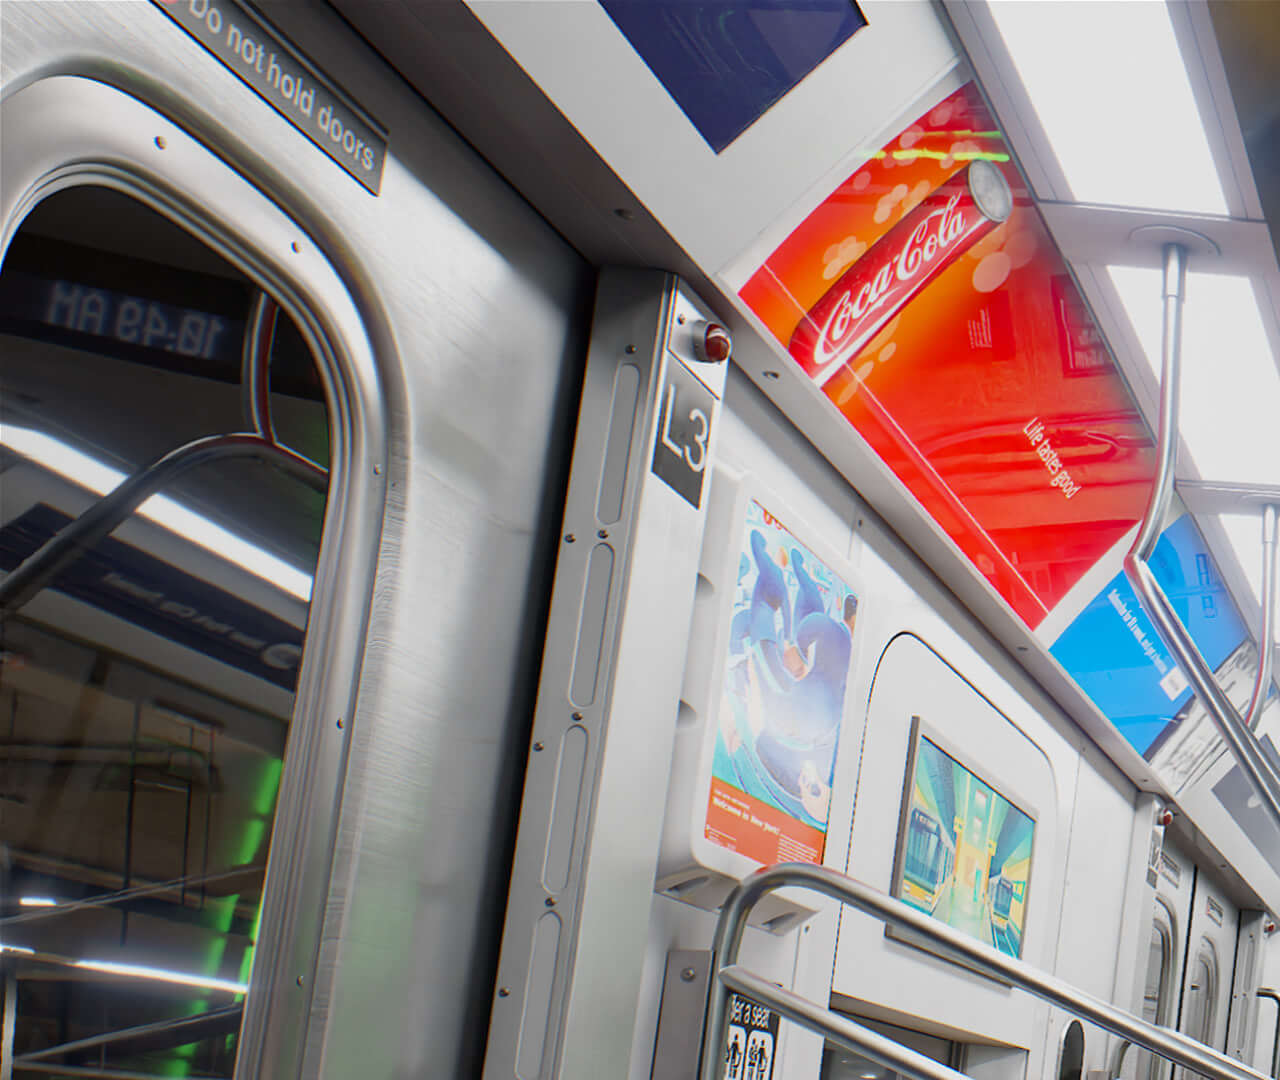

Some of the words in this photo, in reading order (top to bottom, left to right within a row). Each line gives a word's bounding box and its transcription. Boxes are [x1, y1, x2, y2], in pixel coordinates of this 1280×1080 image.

[226, 23, 264, 74] not
[266, 53, 316, 118] hold
[316, 105, 375, 171] doors
[662, 384, 708, 471] L3
[1023, 416, 1046, 446] Life
[1036, 437, 1063, 476] tastes
[1049, 467, 1082, 500] good
